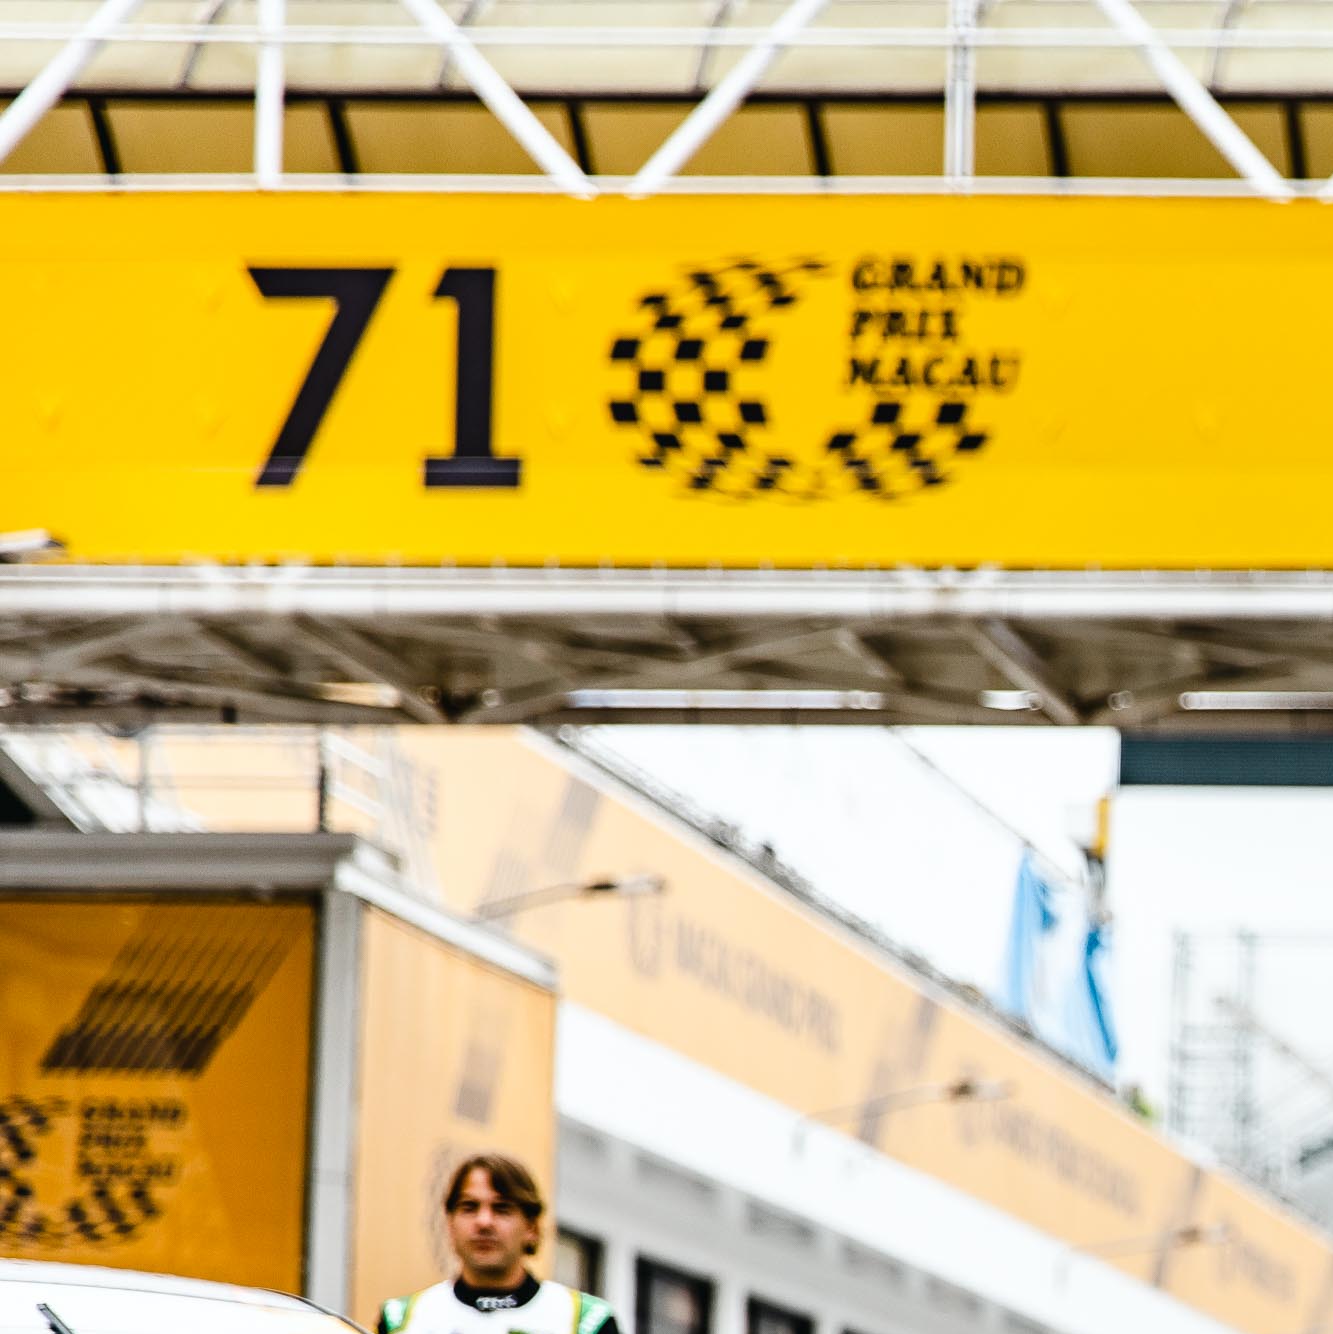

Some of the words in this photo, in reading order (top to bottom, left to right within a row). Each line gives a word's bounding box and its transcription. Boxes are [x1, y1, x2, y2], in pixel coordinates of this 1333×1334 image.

[850, 256, 1026, 294] GRAND
[848, 308, 960, 344] PRIX
[246, 265, 523, 489] 71
[846, 353, 1018, 393] MACAU
